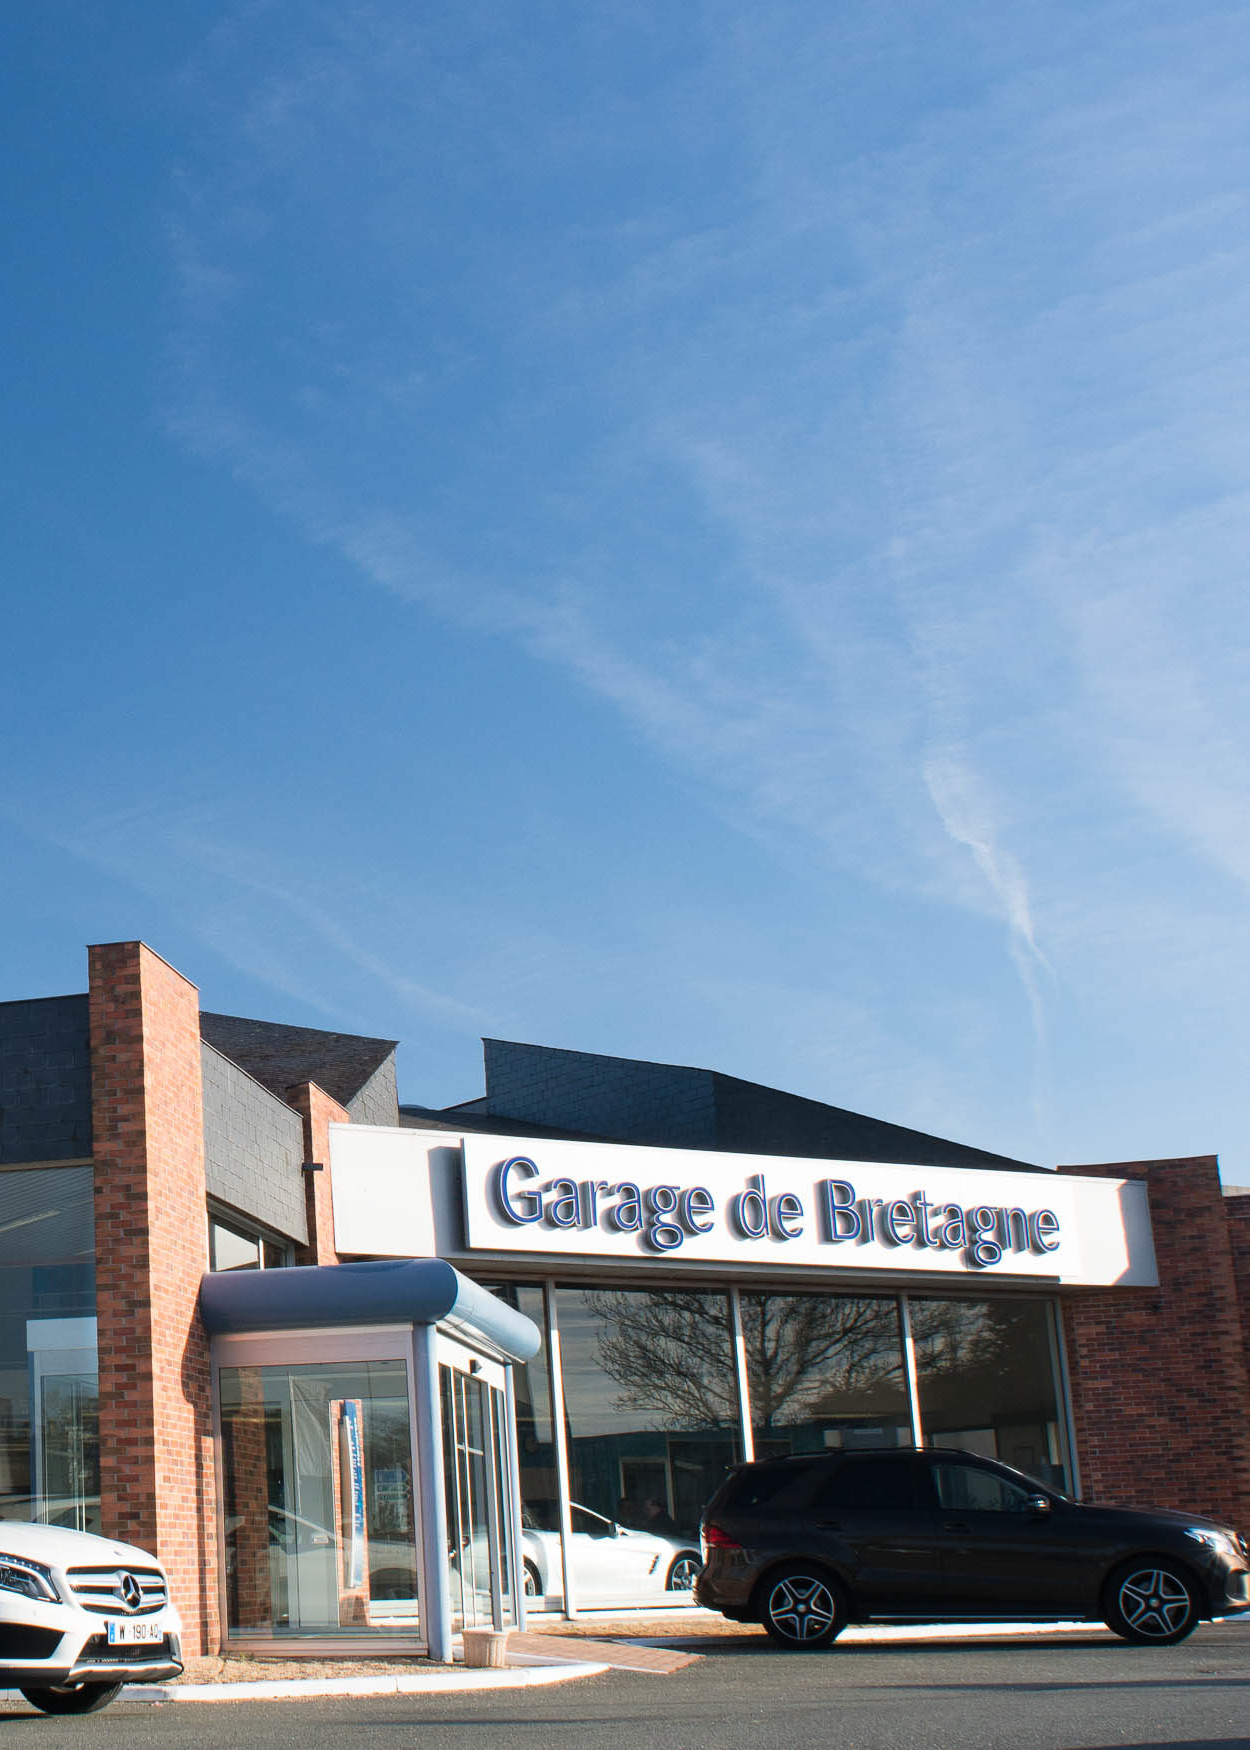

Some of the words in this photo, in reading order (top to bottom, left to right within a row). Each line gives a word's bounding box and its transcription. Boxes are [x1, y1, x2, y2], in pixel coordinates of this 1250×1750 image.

[500, 1156, 715, 1250] Garage
[739, 1174, 804, 1239] de
[827, 1178, 1061, 1267] Bretagne
